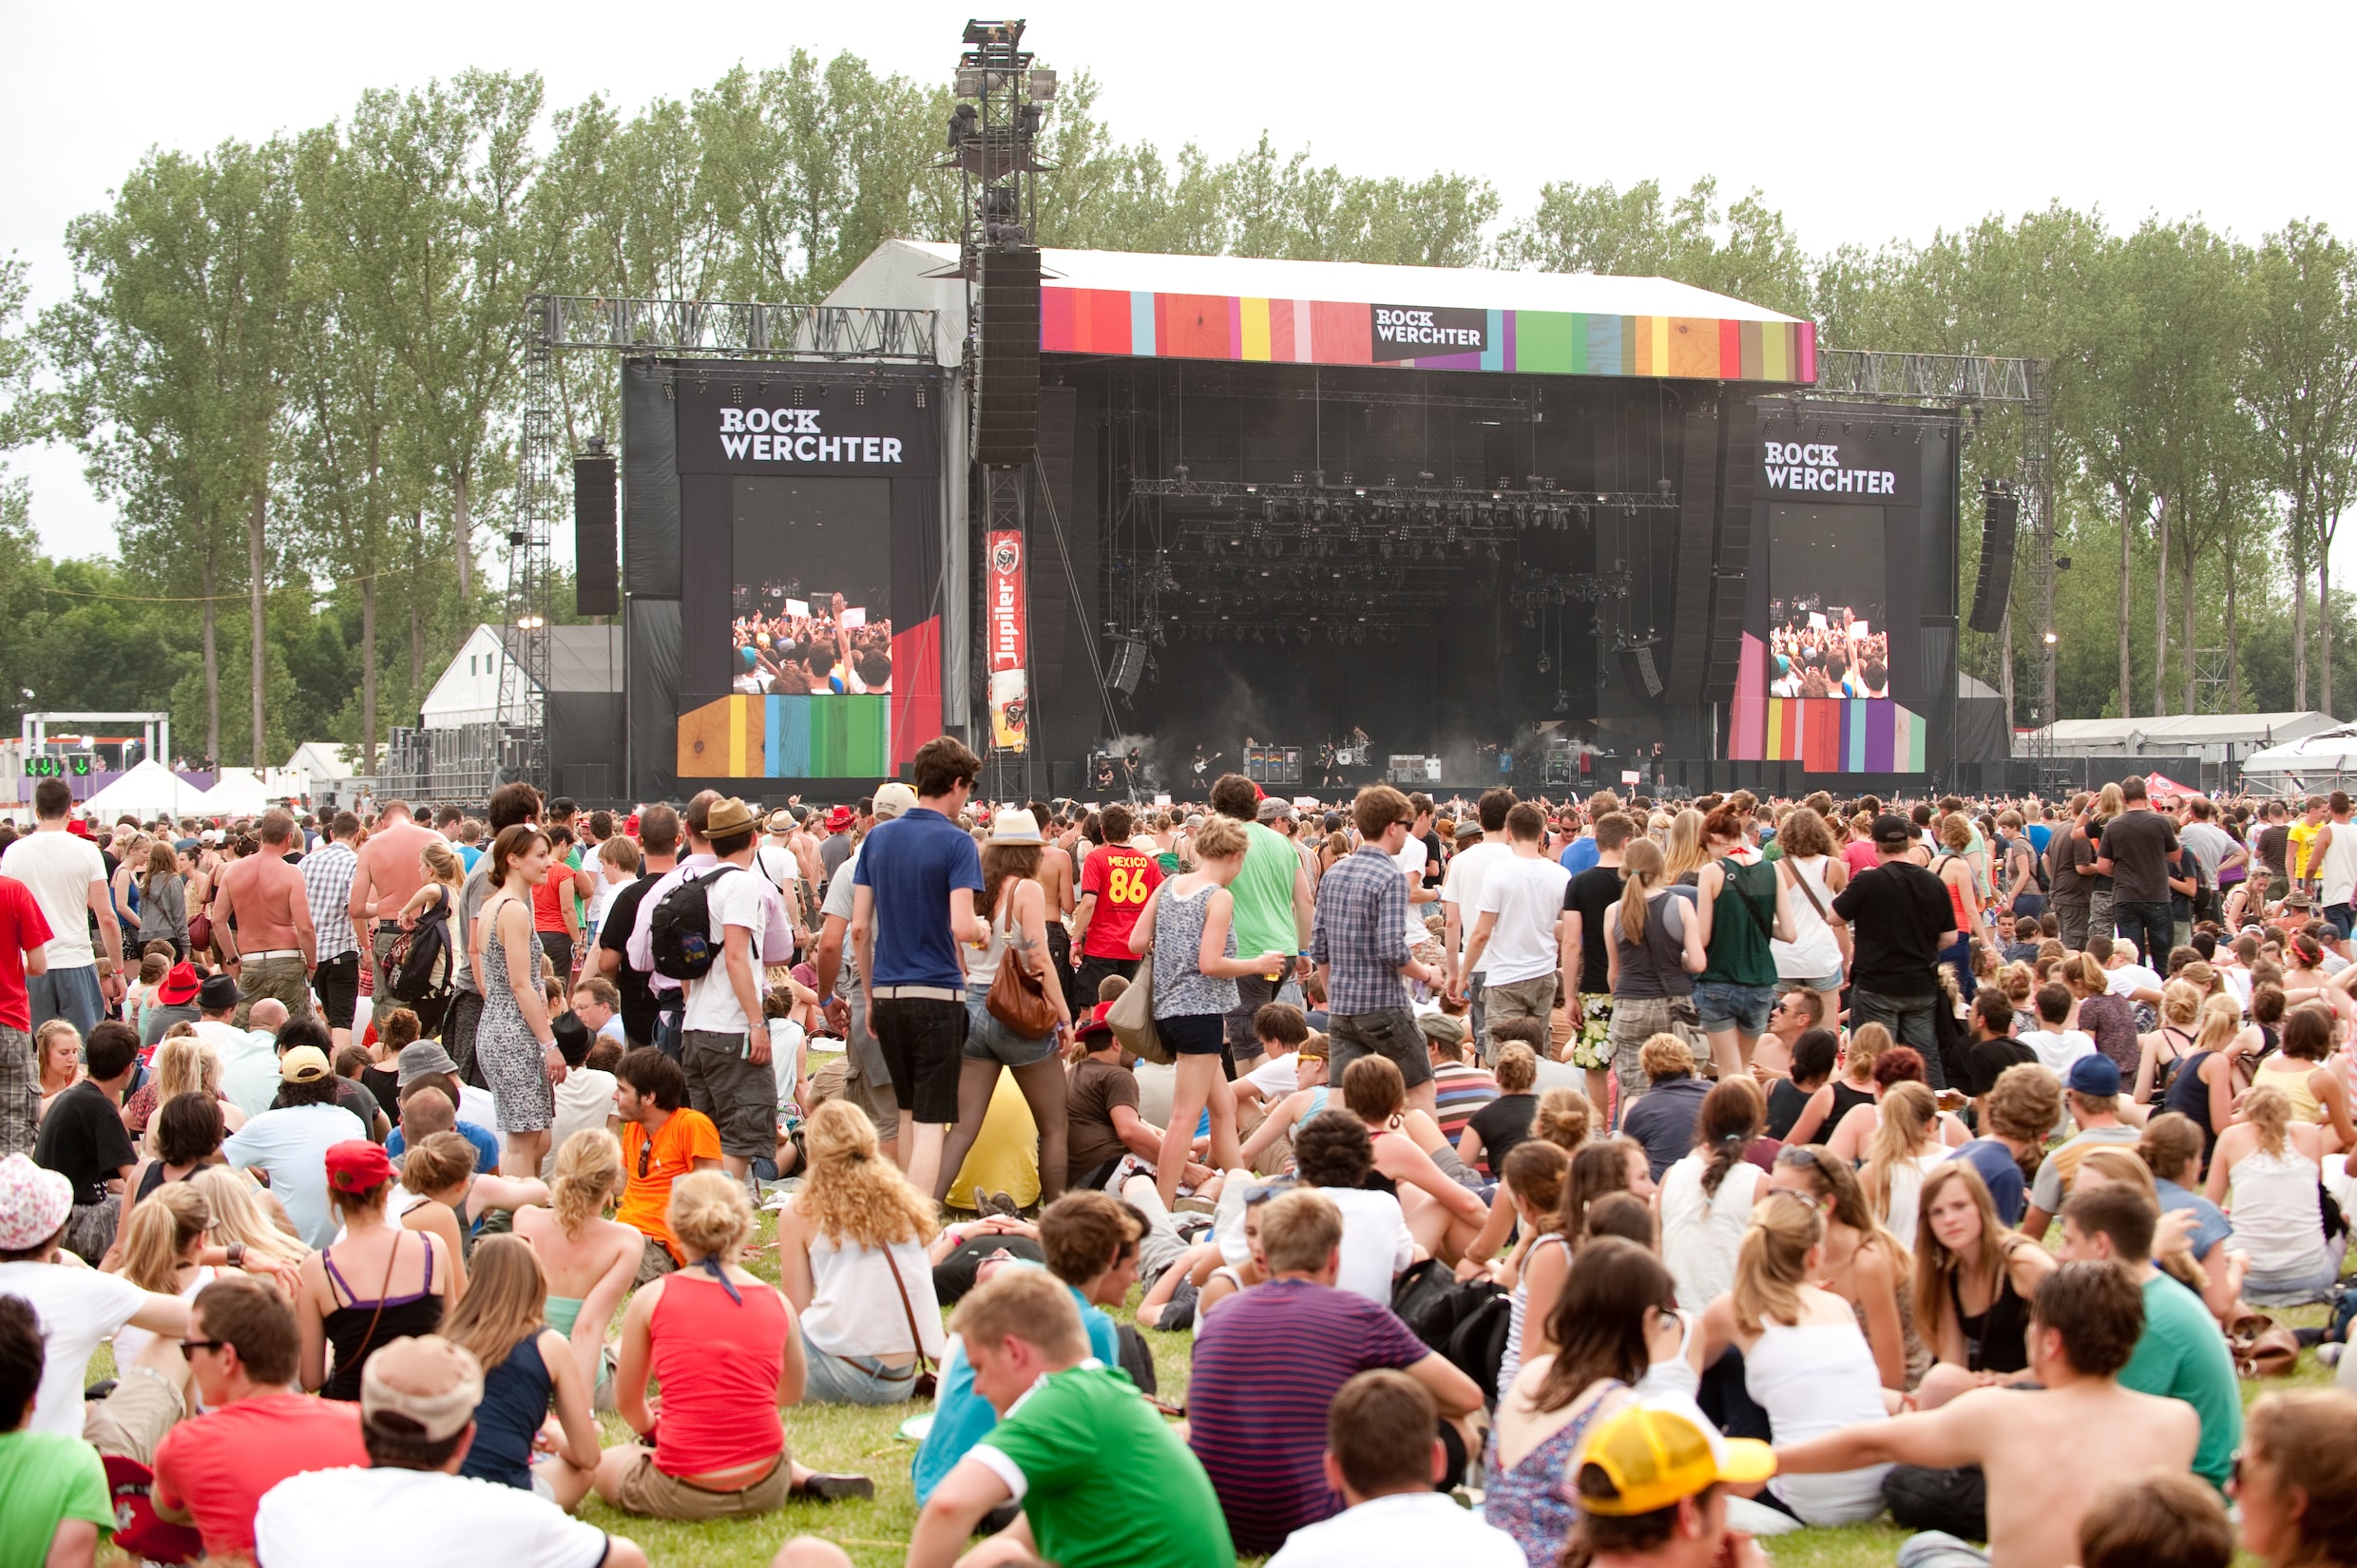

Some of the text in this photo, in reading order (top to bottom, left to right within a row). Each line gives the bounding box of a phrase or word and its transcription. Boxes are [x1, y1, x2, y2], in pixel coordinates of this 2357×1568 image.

[1375, 309, 1434, 327] ROCK
[1376, 325, 1481, 346] WERCHTER
[719, 408, 821, 433] ROCK
[719, 434, 903, 463] WERCHTER
[1764, 441, 1839, 467] ROCK
[1764, 466, 1895, 494] WERCHTER
[994, 578, 1020, 667] Jupiler
[1107, 855, 1148, 868] MEXICO
[1108, 868, 1148, 904] 86
